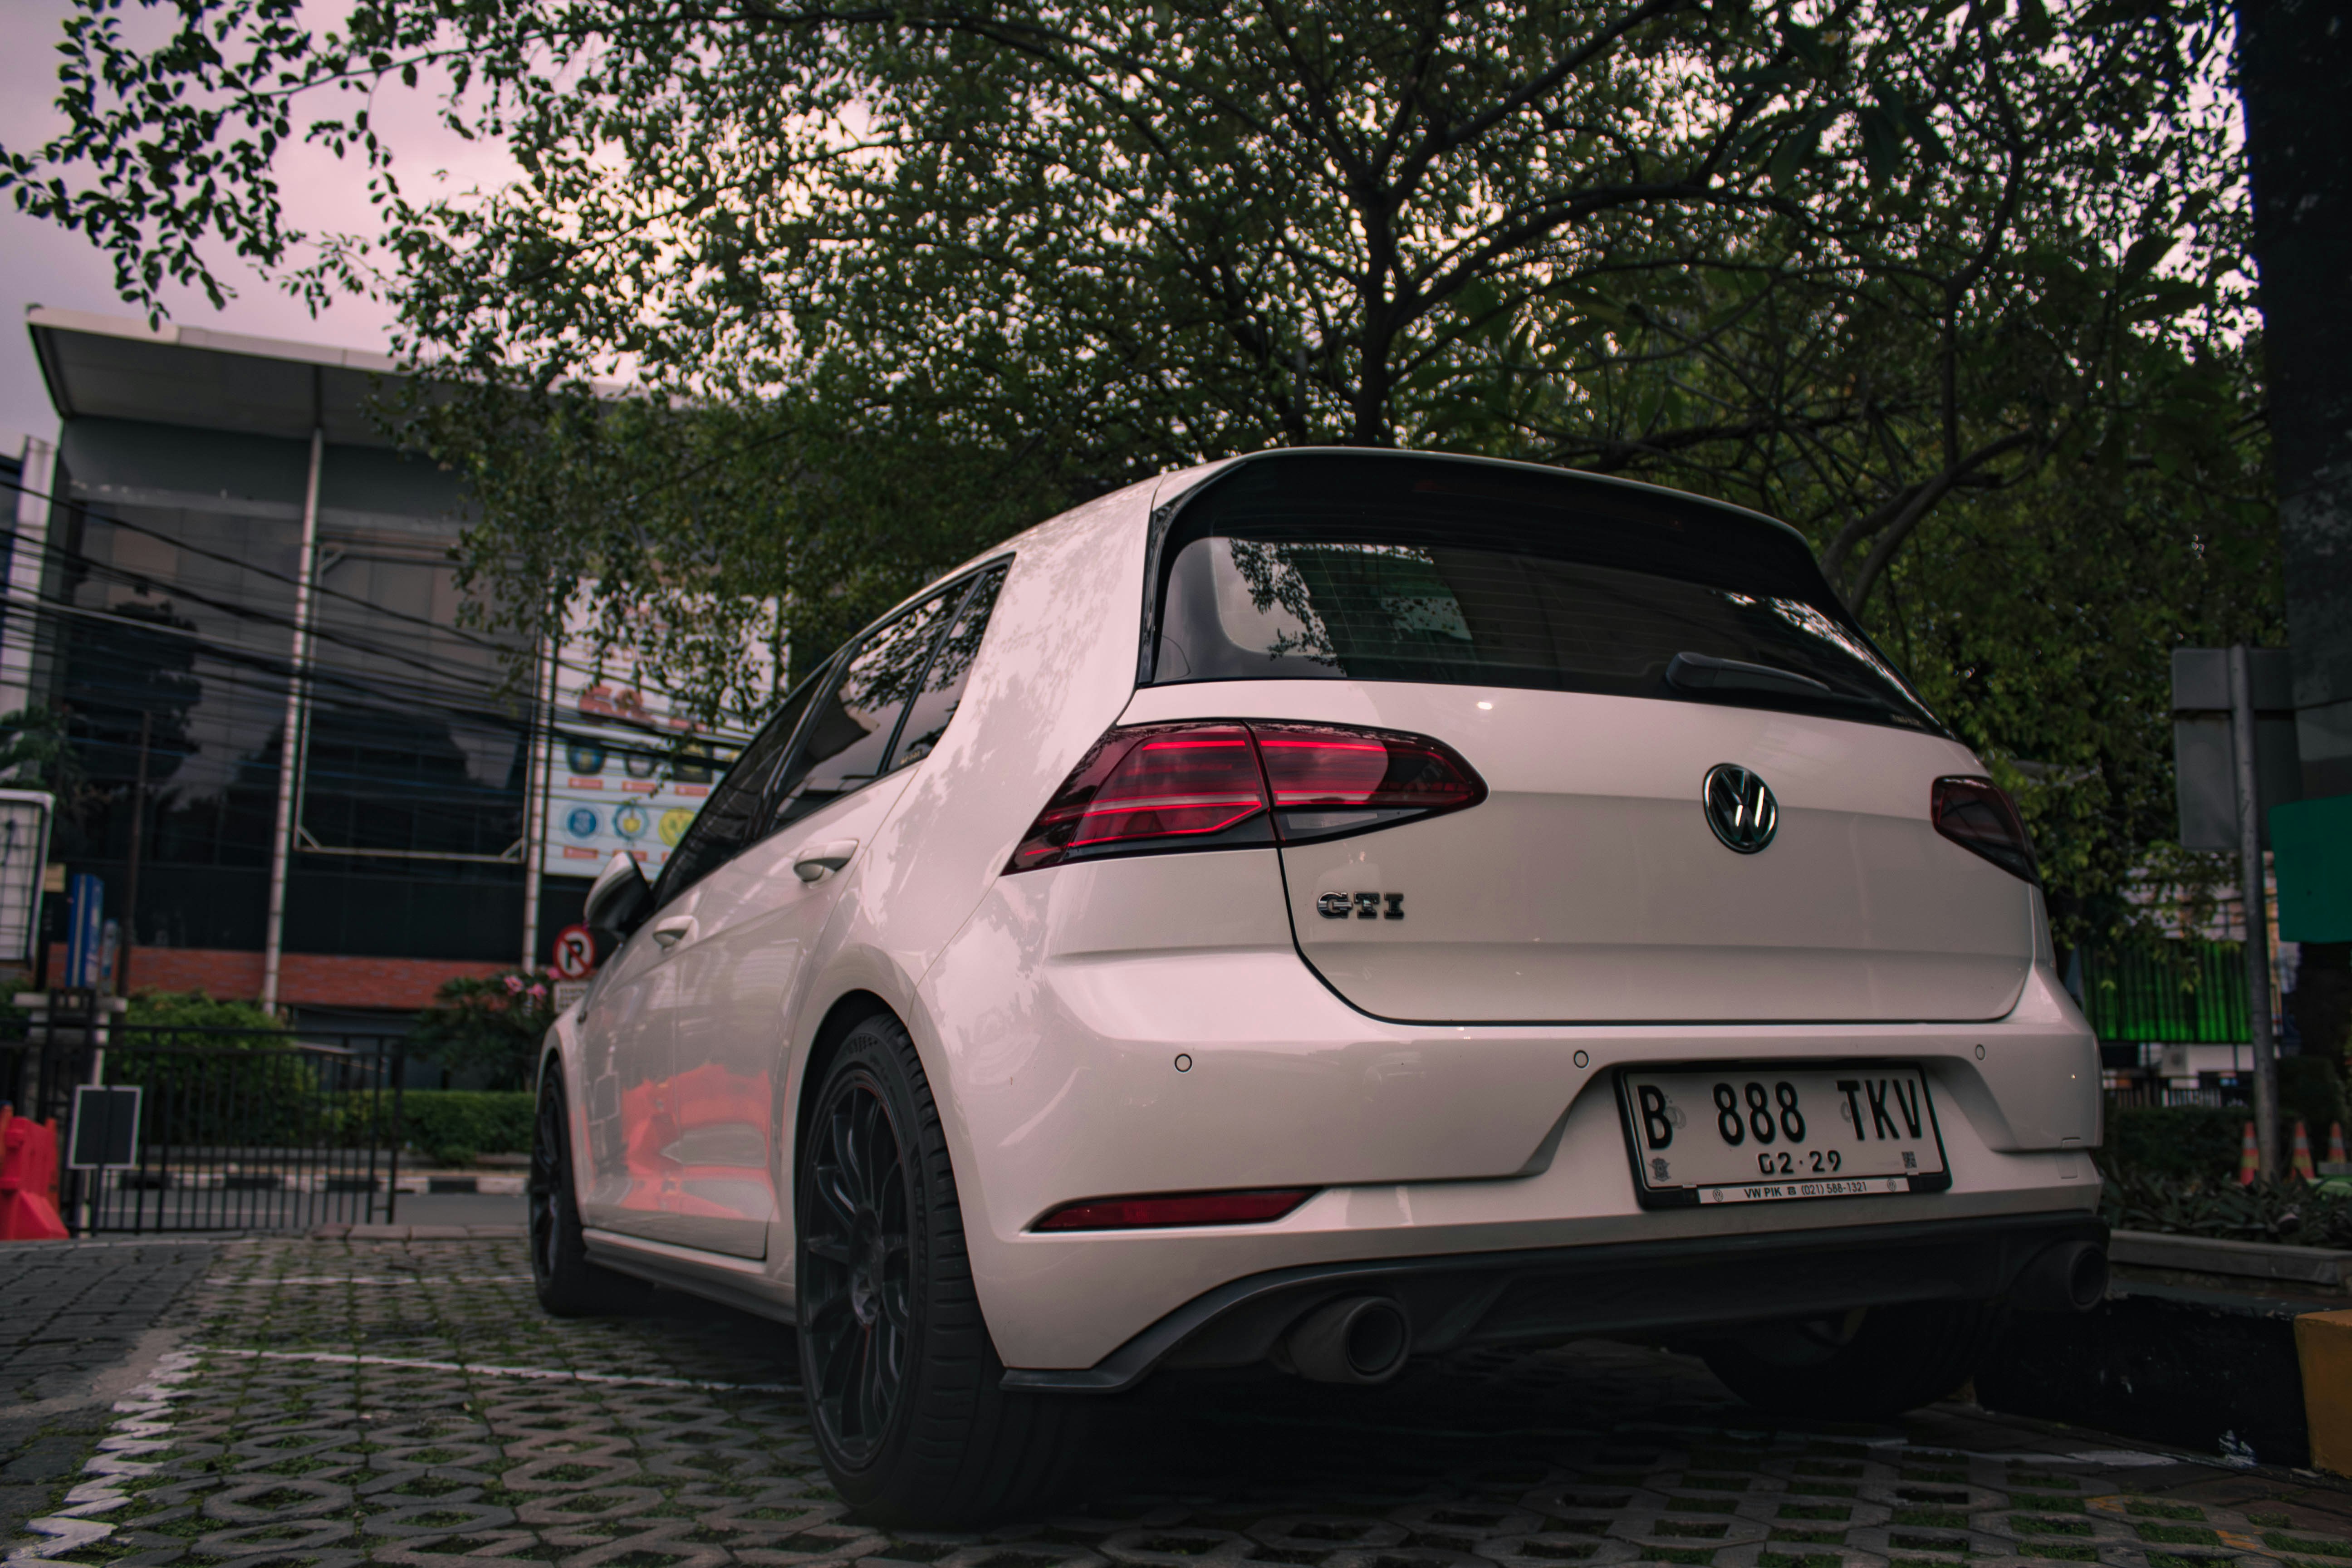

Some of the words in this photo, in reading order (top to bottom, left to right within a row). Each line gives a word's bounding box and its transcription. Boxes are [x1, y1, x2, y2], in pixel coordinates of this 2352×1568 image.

[1317, 892, 1404, 919] GTI
[1637, 1085, 1673, 1149] B
[1713, 1082, 1806, 1146] 888
[1837, 1079, 1922, 1141] TKV
[1744, 1187, 1761, 1198] VW
[1764, 1186, 1782, 1197] PIK
[1801, 1183, 1824, 1196] (021)
[1827, 1181, 1867, 1194] 588-1321
